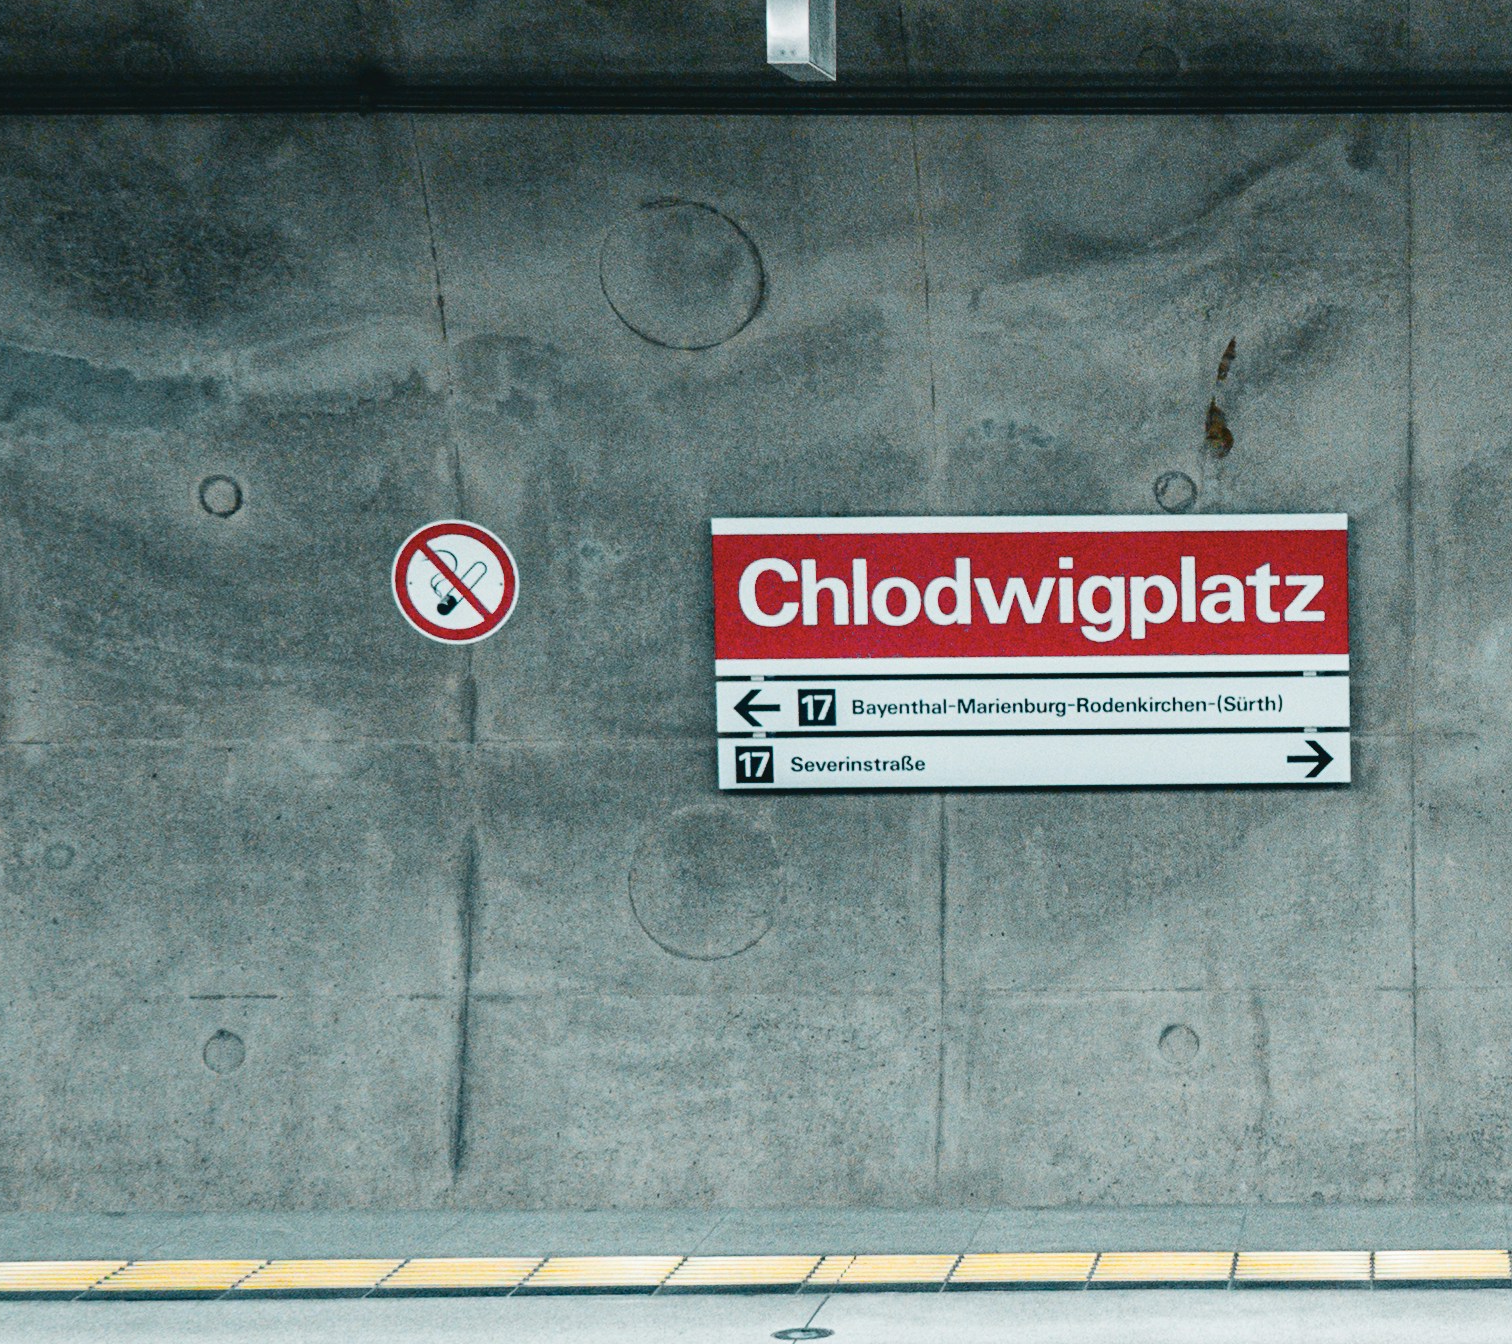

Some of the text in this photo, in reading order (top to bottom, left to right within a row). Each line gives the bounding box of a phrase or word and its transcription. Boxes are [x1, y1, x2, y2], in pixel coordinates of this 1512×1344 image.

[738, 555, 1326, 642] Chlodwigplatz
[801, 694, 1284, 721] 17 Bayenthal-Marienburg-Rodenkirchen-(Sürth)
[738, 751, 926, 778] 17 Severinstraße
